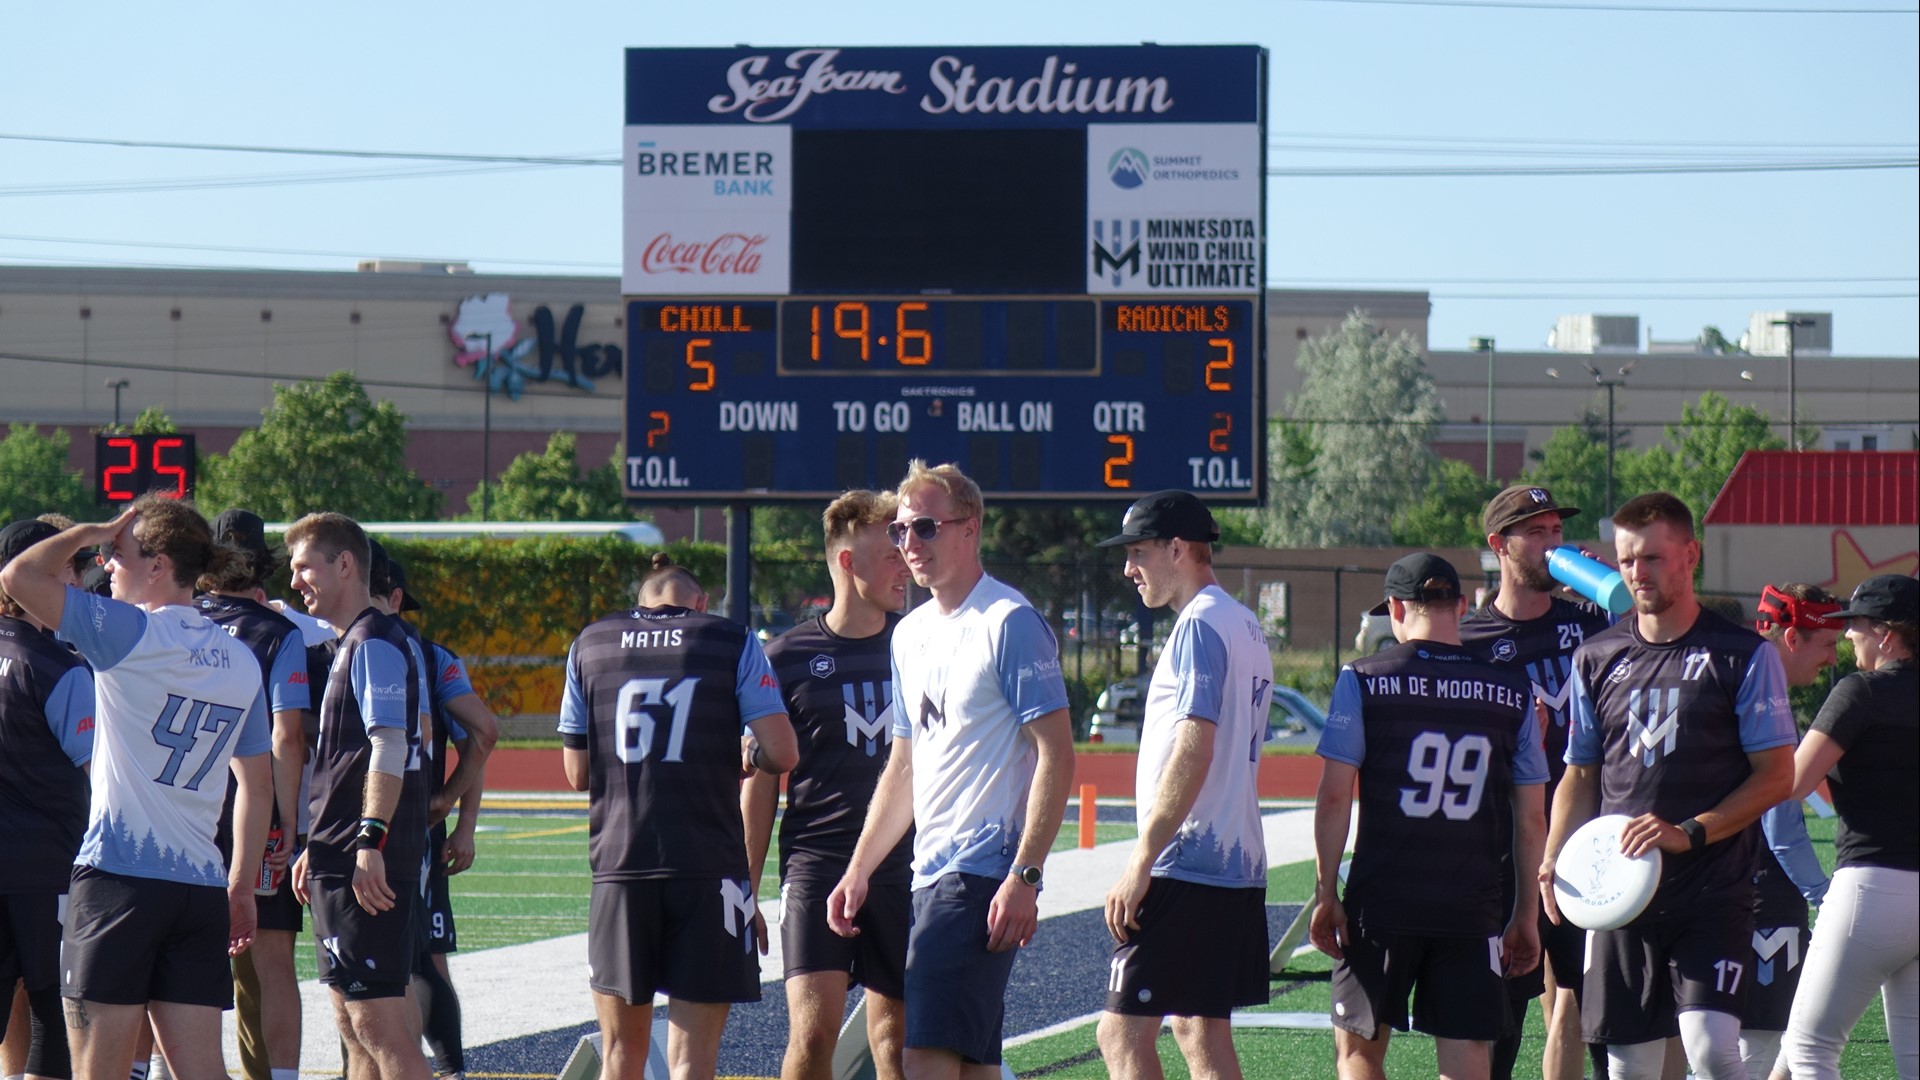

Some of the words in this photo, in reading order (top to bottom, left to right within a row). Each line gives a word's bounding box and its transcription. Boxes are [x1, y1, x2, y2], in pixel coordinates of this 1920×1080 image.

[920, 55, 1174, 114] Stadium
[638, 152, 773, 176] BREMER
[1153, 156, 1202, 167] SUMMIT
[1153, 170, 1239, 181] ORTHOPEDICS
[714, 180, 773, 196] BANK
[1147, 219, 1255, 239] MINNESOTA
[1147, 242, 1199, 261] WIND
[1206, 242, 1255, 261] CHILL
[1147, 264, 1256, 287] ULTIMATE
[660, 305, 752, 332] CHILL
[1117, 305, 1229, 332] RADICALS
[686, 339, 716, 391] 5
[1205, 338, 1235, 391] 2
[719, 402, 798, 432] DOWN
[832, 402, 866, 432] TO
[873, 401, 910, 432] GO
[957, 401, 1014, 432] BALL
[1020, 401, 1053, 432] ON
[1093, 401, 1146, 433] QTR
[103, 438, 185, 500] 25
[627, 457, 690, 487] T.O.L.
[1104, 434, 1134, 488] 2
[1188, 457, 1252, 488] T.O.L.
[621, 629, 683, 648] MATIS
[1557, 623, 1584, 649] 24
[1682, 652, 1710, 681] 17
[1366, 677, 1401, 695] VAN
[1408, 676, 1429, 696] DE
[1437, 679, 1522, 711] MOORTELE
[615, 678, 702, 764] 61
[151, 693, 245, 791] 47
[1399, 731, 1492, 820] 99
[1109, 957, 1127, 993] 11
[1713, 959, 1743, 995] 17
